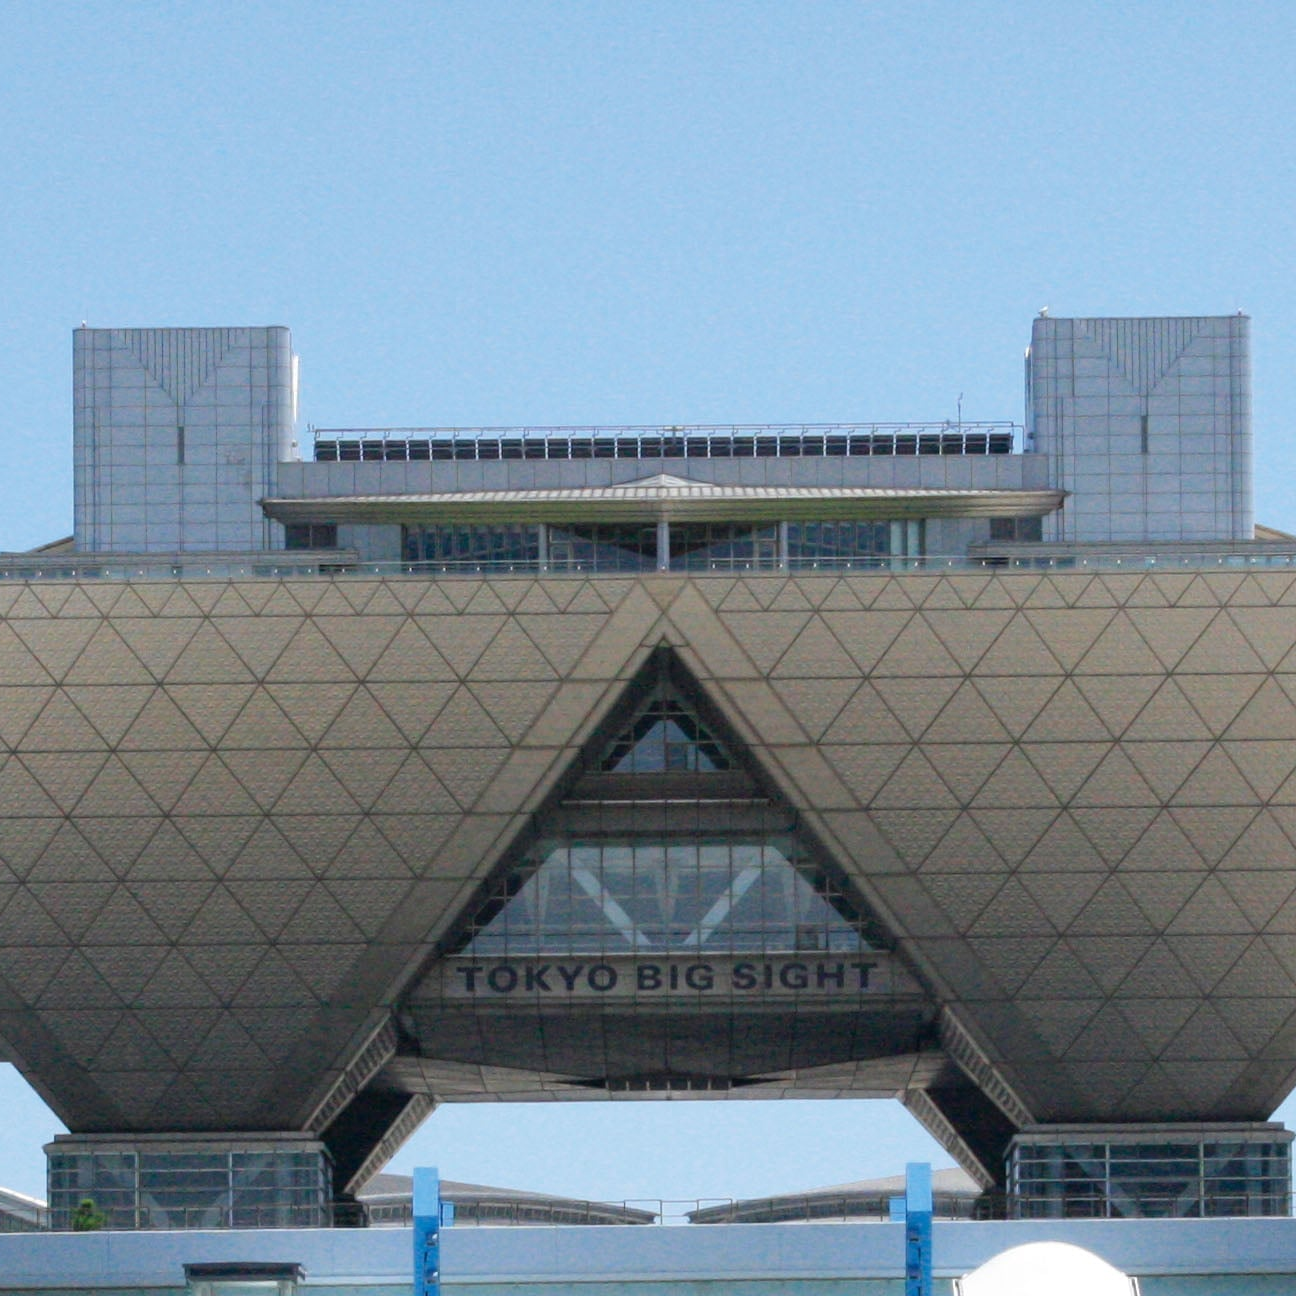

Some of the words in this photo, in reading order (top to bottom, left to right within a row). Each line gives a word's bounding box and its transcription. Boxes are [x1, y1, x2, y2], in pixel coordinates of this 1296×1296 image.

[456, 964, 619, 993] TOKYO
[636, 963, 714, 991] BIG
[731, 961, 878, 990] SIGHT
